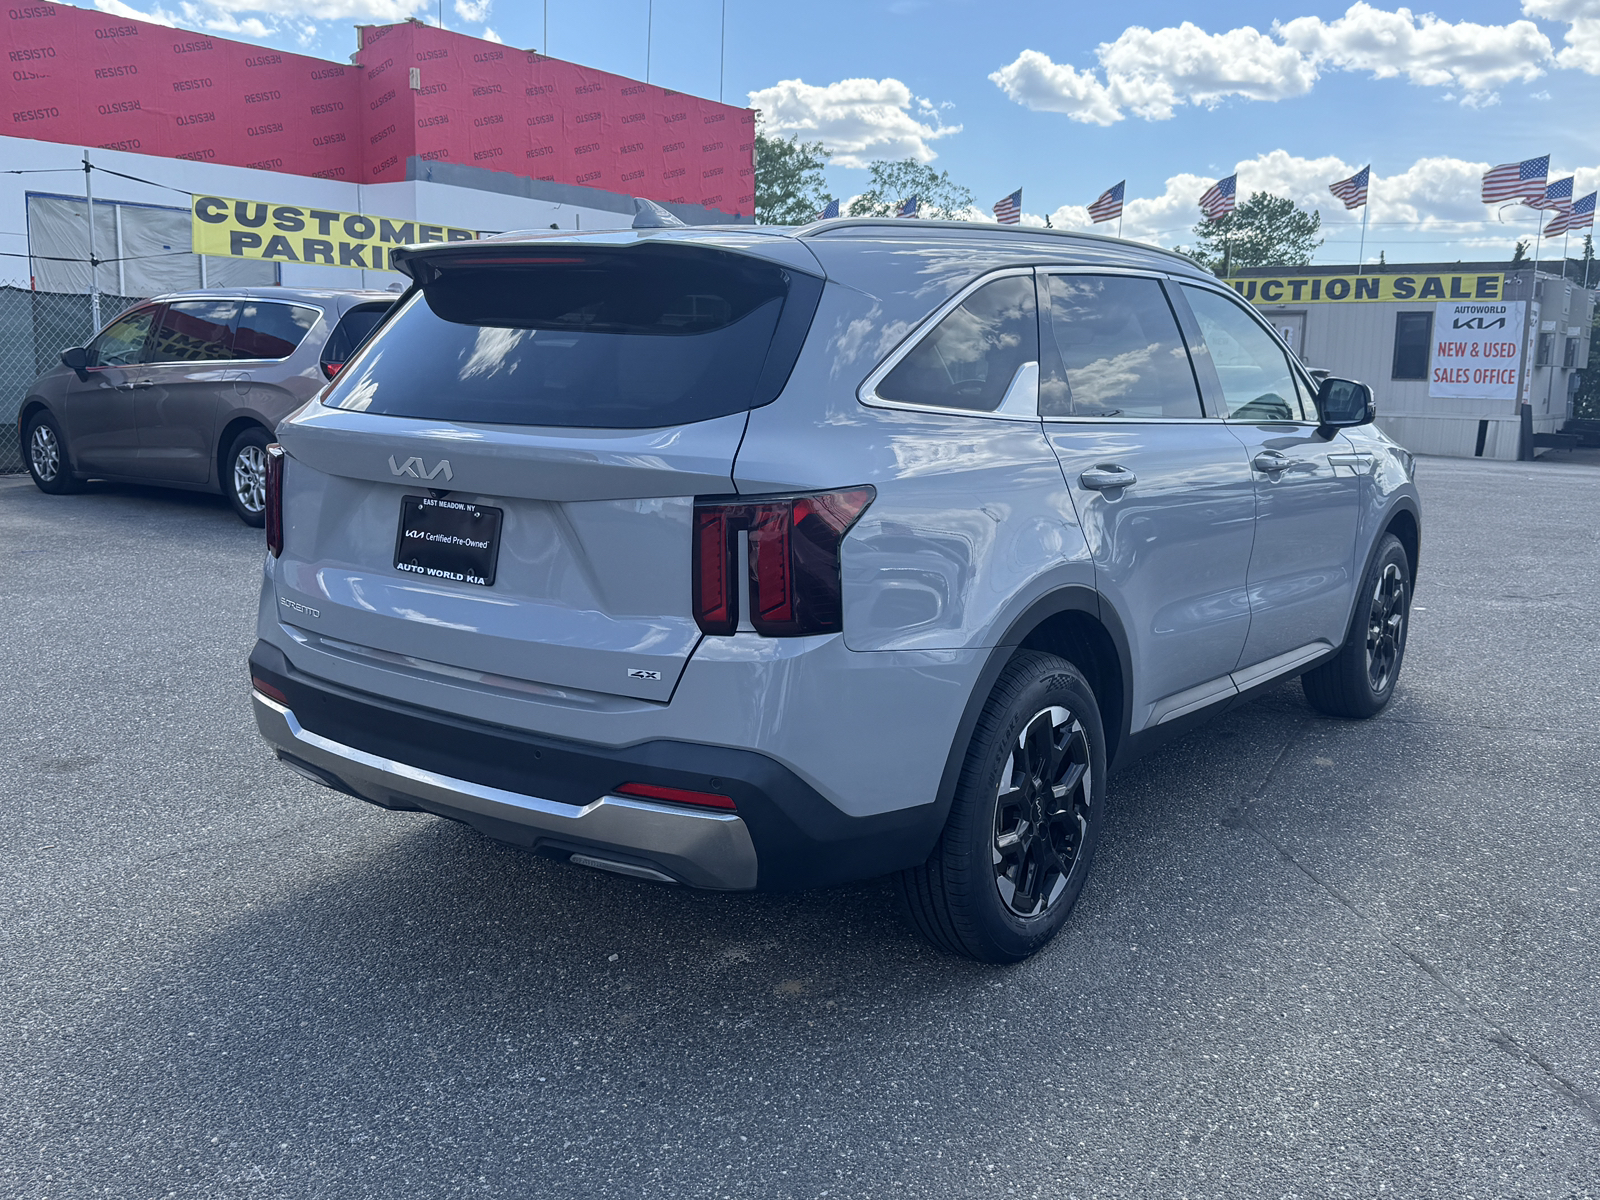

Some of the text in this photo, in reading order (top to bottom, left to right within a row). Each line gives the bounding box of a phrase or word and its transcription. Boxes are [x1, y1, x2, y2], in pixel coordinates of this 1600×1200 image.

[10, 6, 56, 20] RESISTO
[95, 26, 138, 39] RESISTO
[174, 40, 213, 54] RESISTO
[9, 48, 56, 62] RESISTO
[246, 54, 282, 67] RESISTO
[417, 49, 448, 62] RESISTO
[474, 51, 503, 62] RESISTO
[95, 65, 138, 79] RESISTO
[311, 67, 344, 80] RESISTO
[368, 59, 393, 79] RESISTO
[173, 78, 212, 92] RESISTO
[417, 84, 447, 96] RESISTO
[473, 84, 501, 97] RESISTO
[525, 85, 553, 96] RESISTO
[575, 84, 601, 95] RESISTO
[621, 85, 646, 96] RESISTO
[245, 90, 281, 104] RESISTO
[370, 90, 396, 111] RESISTO
[98, 100, 141, 115] RESISTO
[311, 102, 344, 116] RESISTO
[13, 107, 59, 122] RESISTO
[176, 112, 215, 126] RESISTO
[418, 114, 449, 128] RESISTO
[474, 114, 503, 127] RESISTO
[527, 114, 554, 126] RESISTO
[575, 112, 601, 124] RESISTO
[622, 113, 645, 124] RESISTO
[663, 113, 686, 124] RESISTO
[704, 113, 725, 125] RESISTO
[248, 123, 283, 136] RESISTO
[370, 124, 396, 145] RESISTO
[98, 139, 140, 151] ESISTO
[313, 134, 346, 146] RESISTO
[526, 146, 554, 159] RESISTO
[574, 143, 600, 154] RESISTO
[620, 142, 643, 154] RESISTO
[662, 142, 685, 152] RESISTO
[703, 142, 723, 152] RESISTO
[473, 147, 503, 161] RESISTO
[372, 155, 398, 175] RESISTO
[577, 171, 601, 184] RESISTO
[622, 170, 644, 182] RESISTO
[663, 168, 685, 179] RESISTO
[703, 167, 723, 178] RESISTO
[701, 195, 722, 206] RESISTO
[230, 230, 394, 270] PARKI
[1226, 276, 1500, 302] UCTION SALE
[1454, 305, 1507, 315] AUTOWORLD
[1452, 317, 1506, 330] KIA
[1438, 342, 1517, 358] NEW & USED
[1433, 367, 1516, 385] SALES OFFICE
[388, 455, 454, 482] KIA
[423, 499, 438, 507] EAST
[467, 504, 476, 512] NY
[405, 529, 425, 538] KIA
[425, 532, 452, 544] Certified
[397, 562, 486, 585] AUTO WORLD KIA
[280, 597, 320, 618] SORENTO
